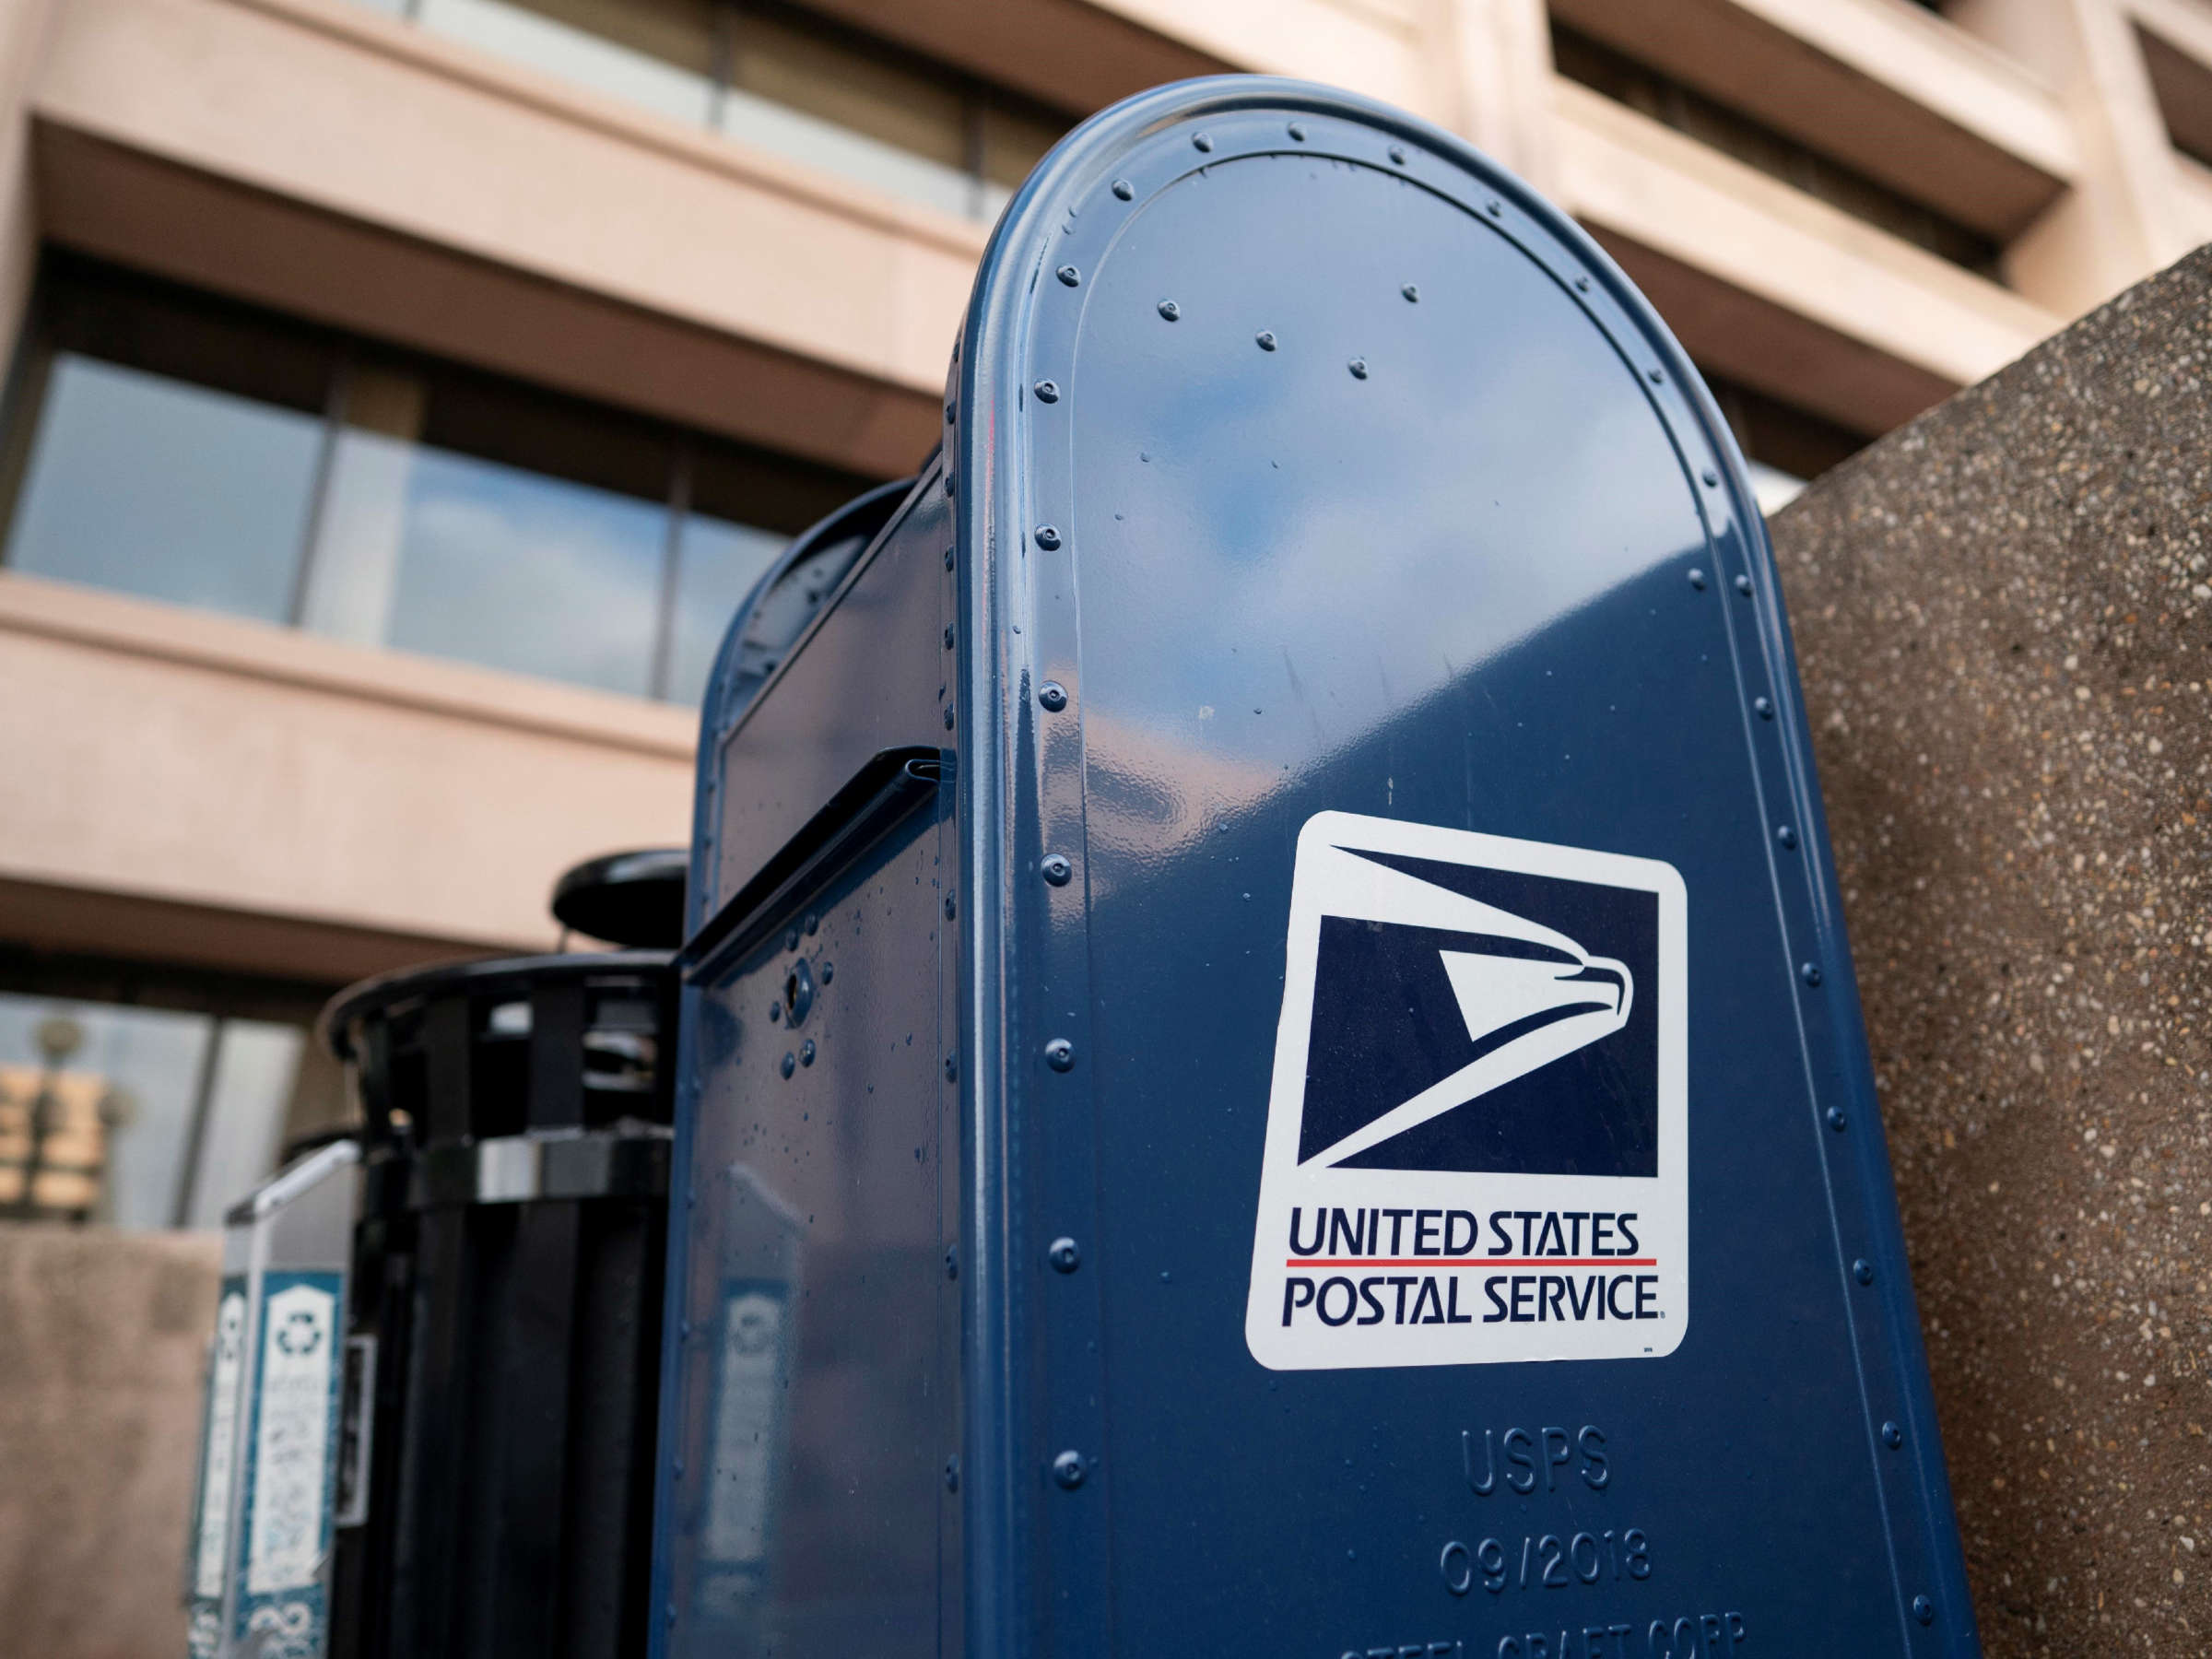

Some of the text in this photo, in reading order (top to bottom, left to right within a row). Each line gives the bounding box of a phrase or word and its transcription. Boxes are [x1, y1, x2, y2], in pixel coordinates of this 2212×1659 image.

[1288, 1206, 1640, 1256] UNITED STATES
[1281, 1274, 1660, 1327] POSTAL SERVICE
[1461, 1424, 1611, 1495] USPS
[1440, 1527, 1653, 1596] 09/2018
[1648, 1611, 1746, 1659] CORP
